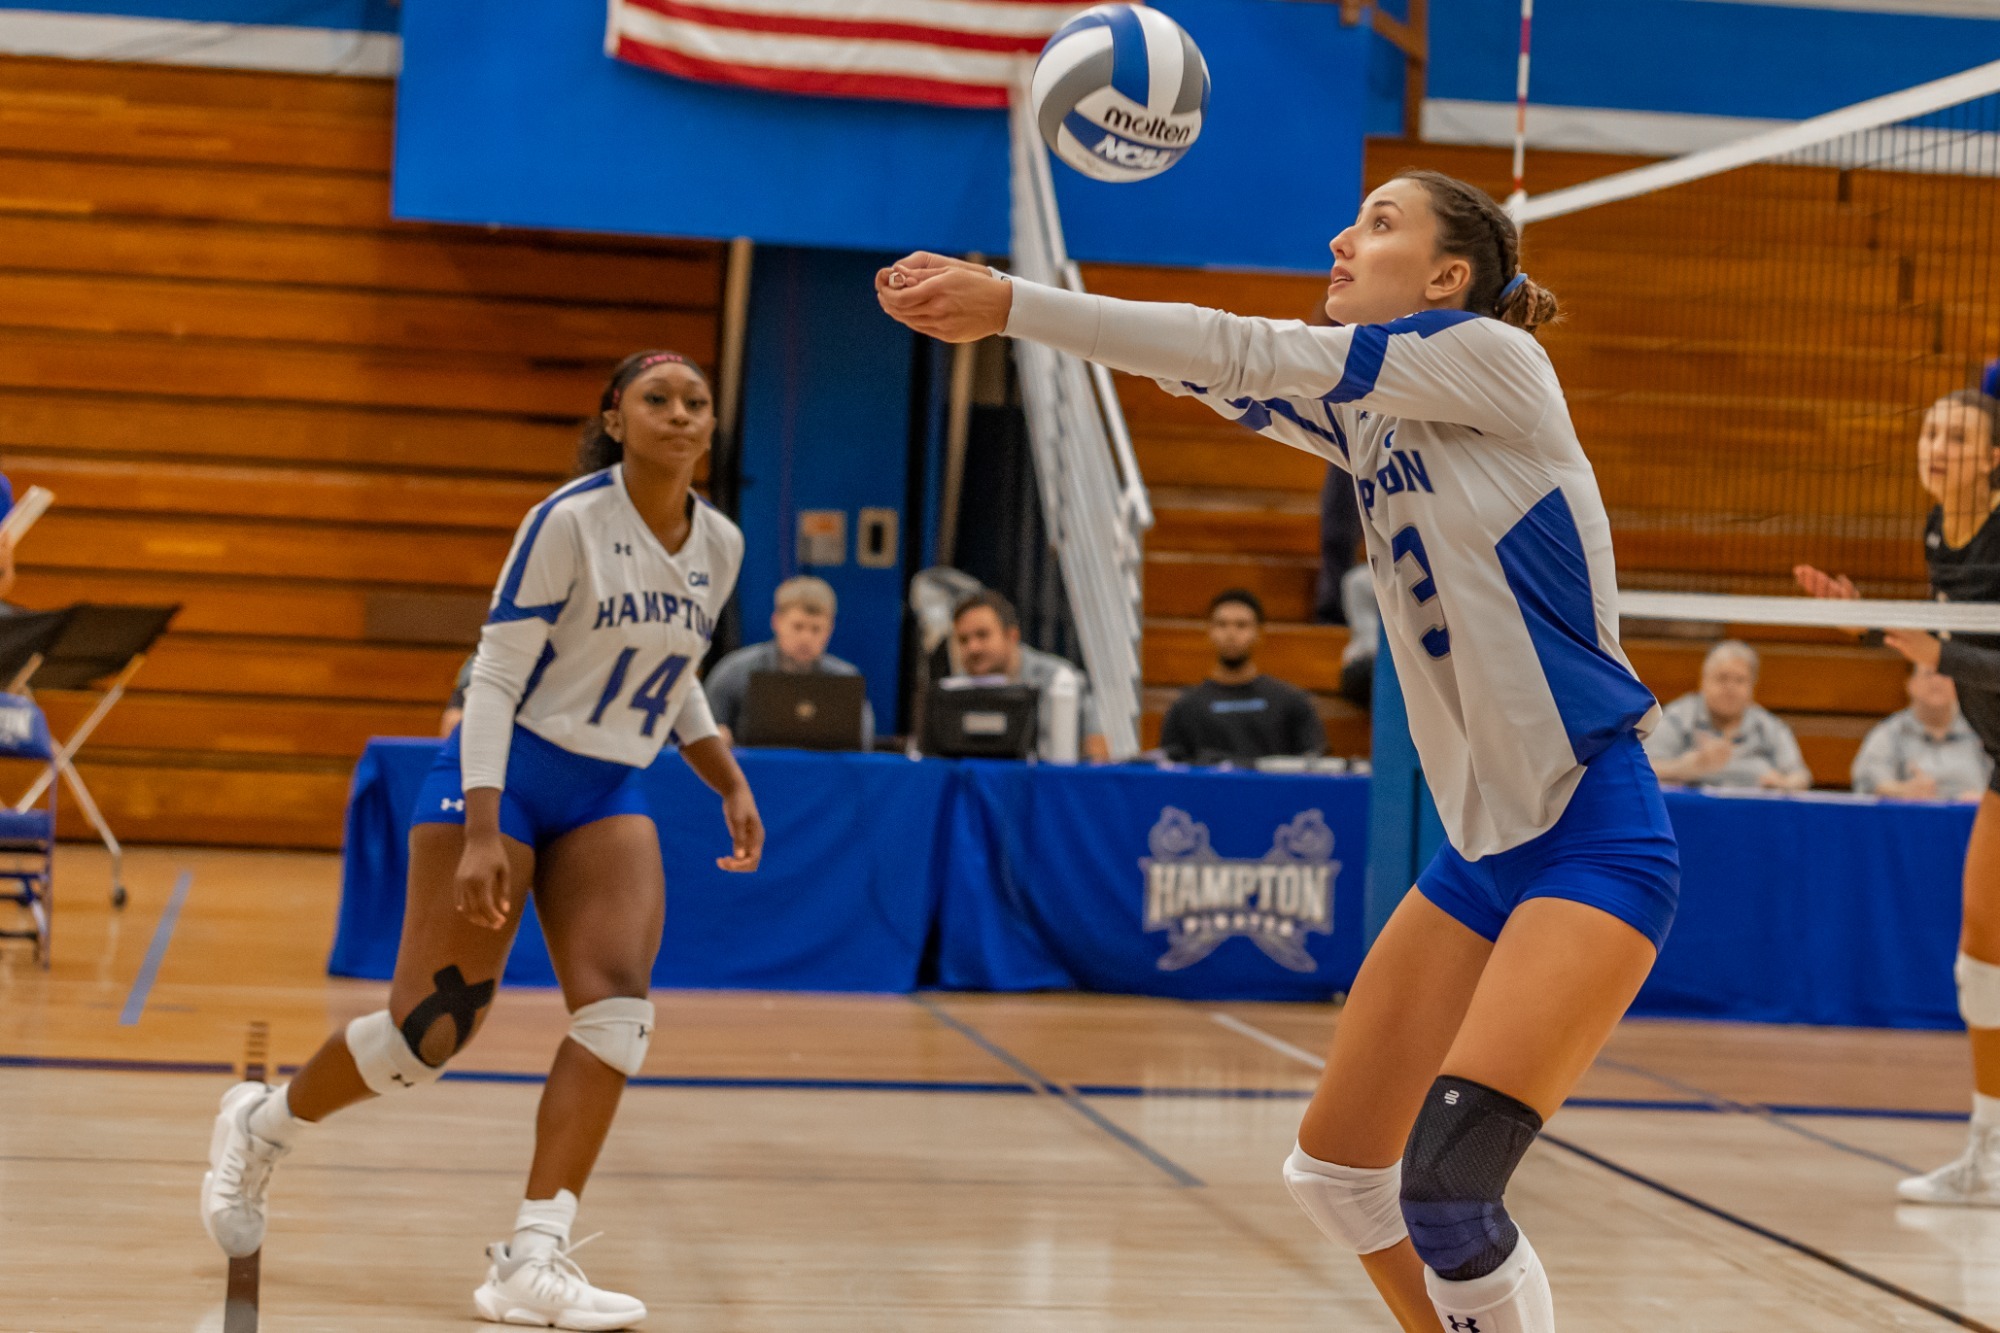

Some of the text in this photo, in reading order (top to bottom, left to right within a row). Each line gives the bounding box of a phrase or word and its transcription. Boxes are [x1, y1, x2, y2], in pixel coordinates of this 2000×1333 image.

[1103, 106, 1191, 144] molten
[587, 646, 691, 738] 14
[1149, 863, 1330, 923] HAMPTON
